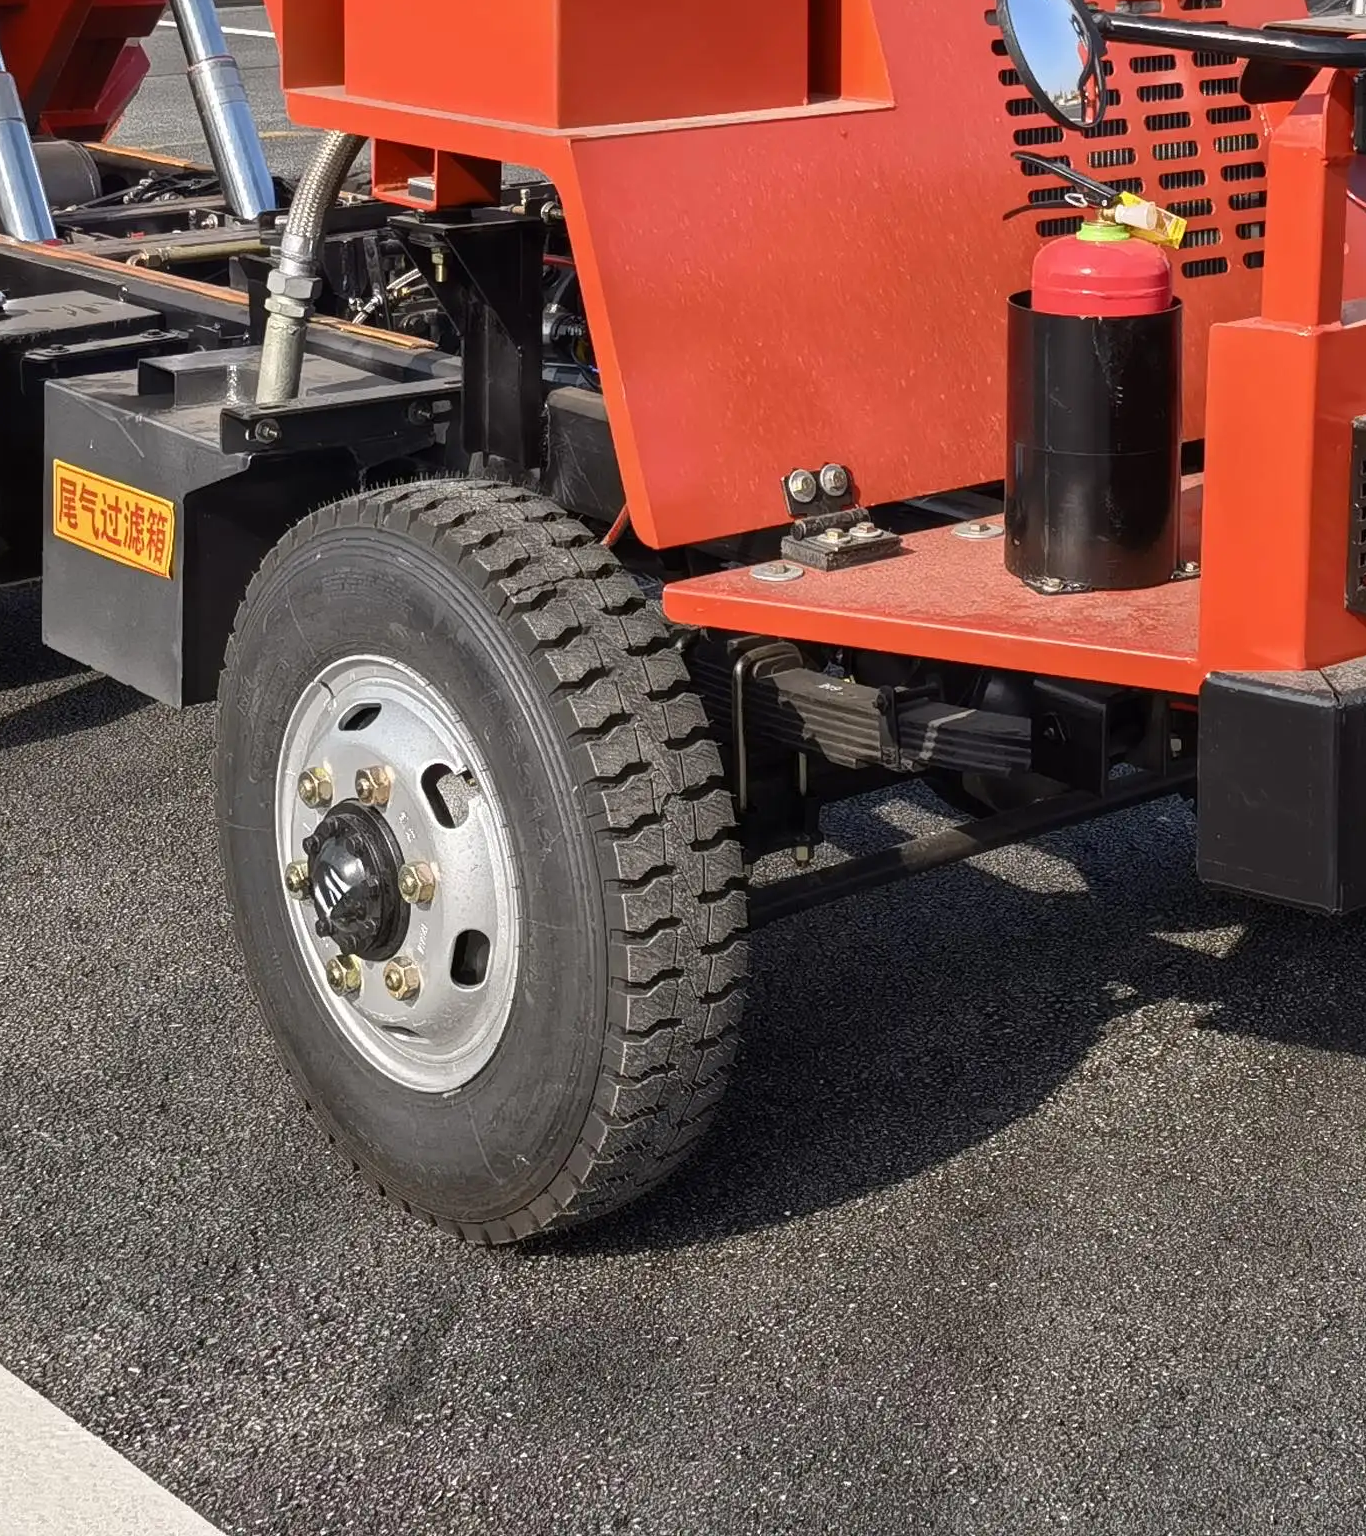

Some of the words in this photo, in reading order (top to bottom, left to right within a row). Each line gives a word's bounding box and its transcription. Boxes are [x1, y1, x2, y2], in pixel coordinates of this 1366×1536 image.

[59, 476, 168, 566] 尾气过滤箱
